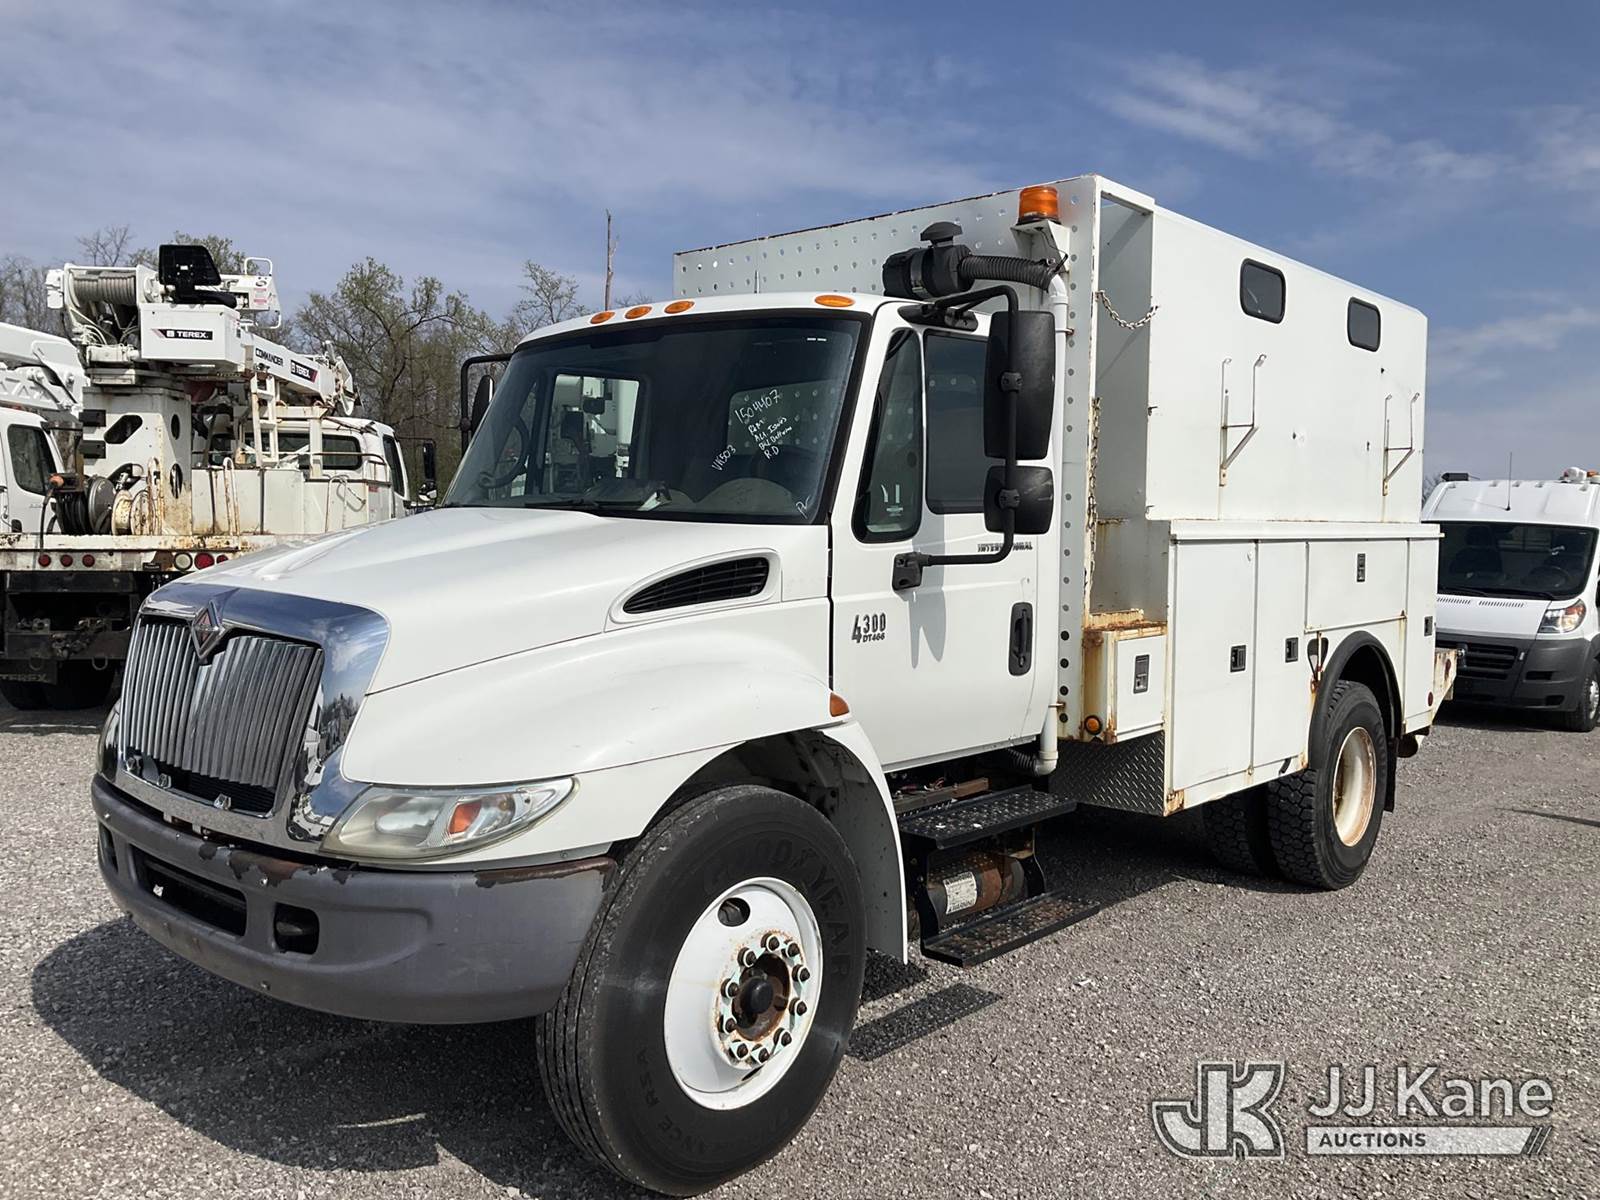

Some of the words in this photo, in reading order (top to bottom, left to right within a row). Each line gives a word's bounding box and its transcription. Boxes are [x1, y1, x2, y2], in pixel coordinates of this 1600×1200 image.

[177, 331, 208, 339] TEREX
[734, 389, 780, 423] 1504407
[852, 613, 887, 643] 4300
